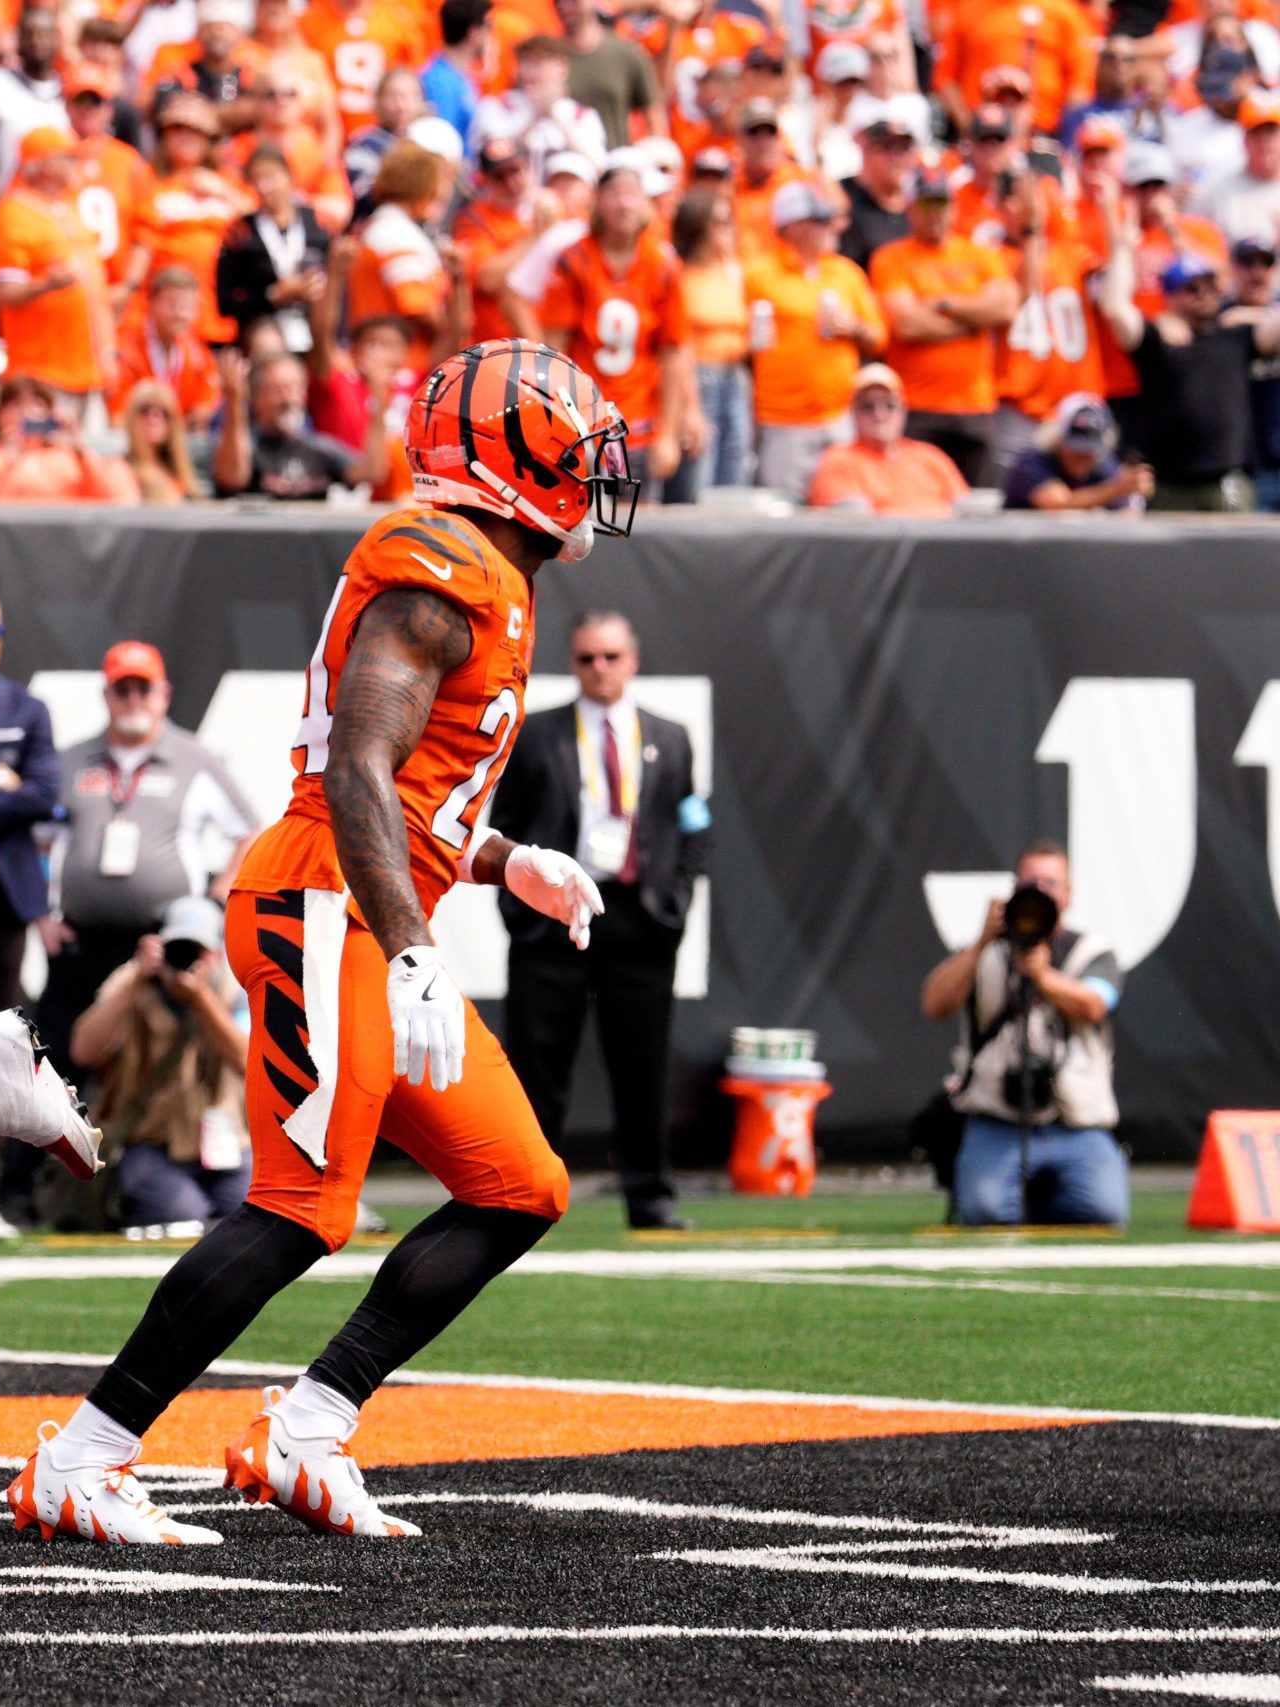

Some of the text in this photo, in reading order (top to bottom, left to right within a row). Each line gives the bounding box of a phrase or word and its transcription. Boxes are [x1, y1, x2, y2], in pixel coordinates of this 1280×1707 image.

[334, 40, 387, 113] 9
[76, 186, 120, 260] 9
[593, 297, 640, 377] 9
[1006, 286, 1089, 363] 40
[506, 606, 523, 641] C
